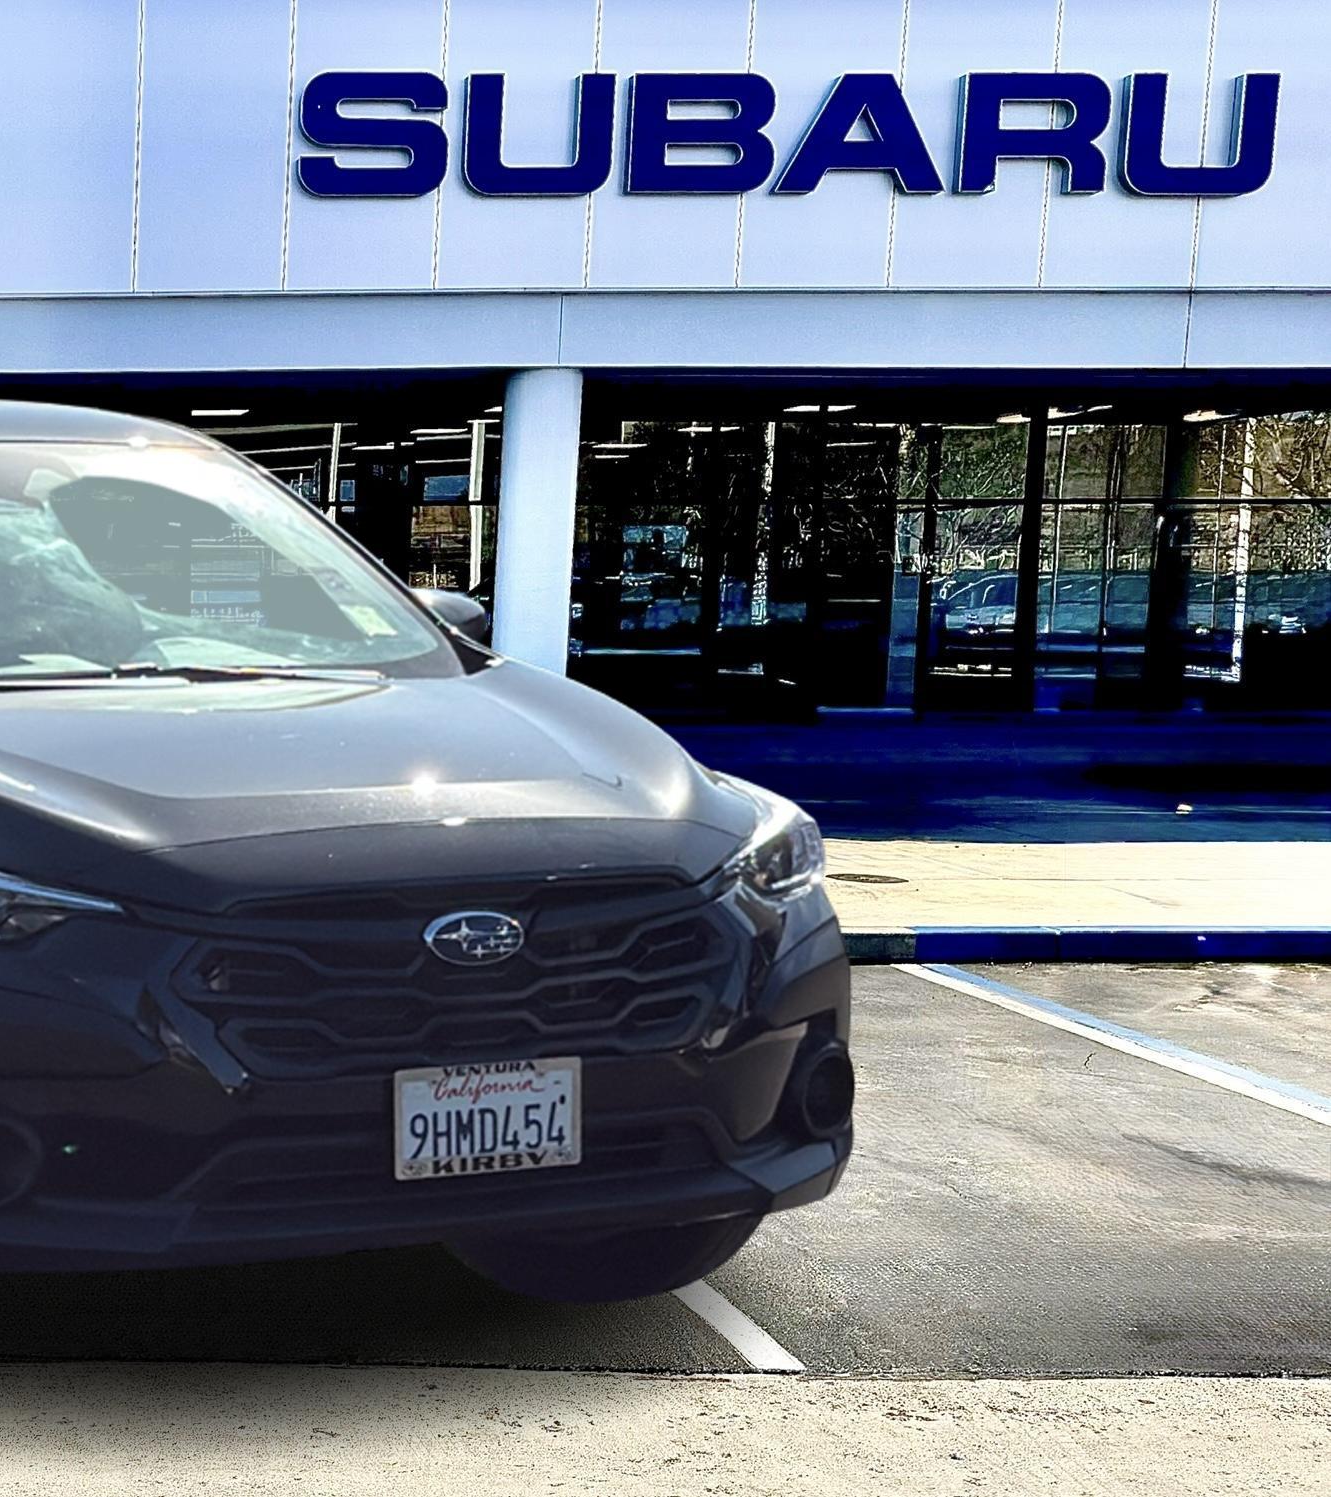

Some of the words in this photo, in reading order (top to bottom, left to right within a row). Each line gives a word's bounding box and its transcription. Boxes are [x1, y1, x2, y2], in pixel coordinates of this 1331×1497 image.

[297, 71, 1280, 197] SUBARU
[443, 1061, 536, 1077] VENTURA
[434, 1076, 545, 1104] California
[409, 1101, 566, 1160] 9HMD454
[432, 1151, 548, 1175] KIRBY
